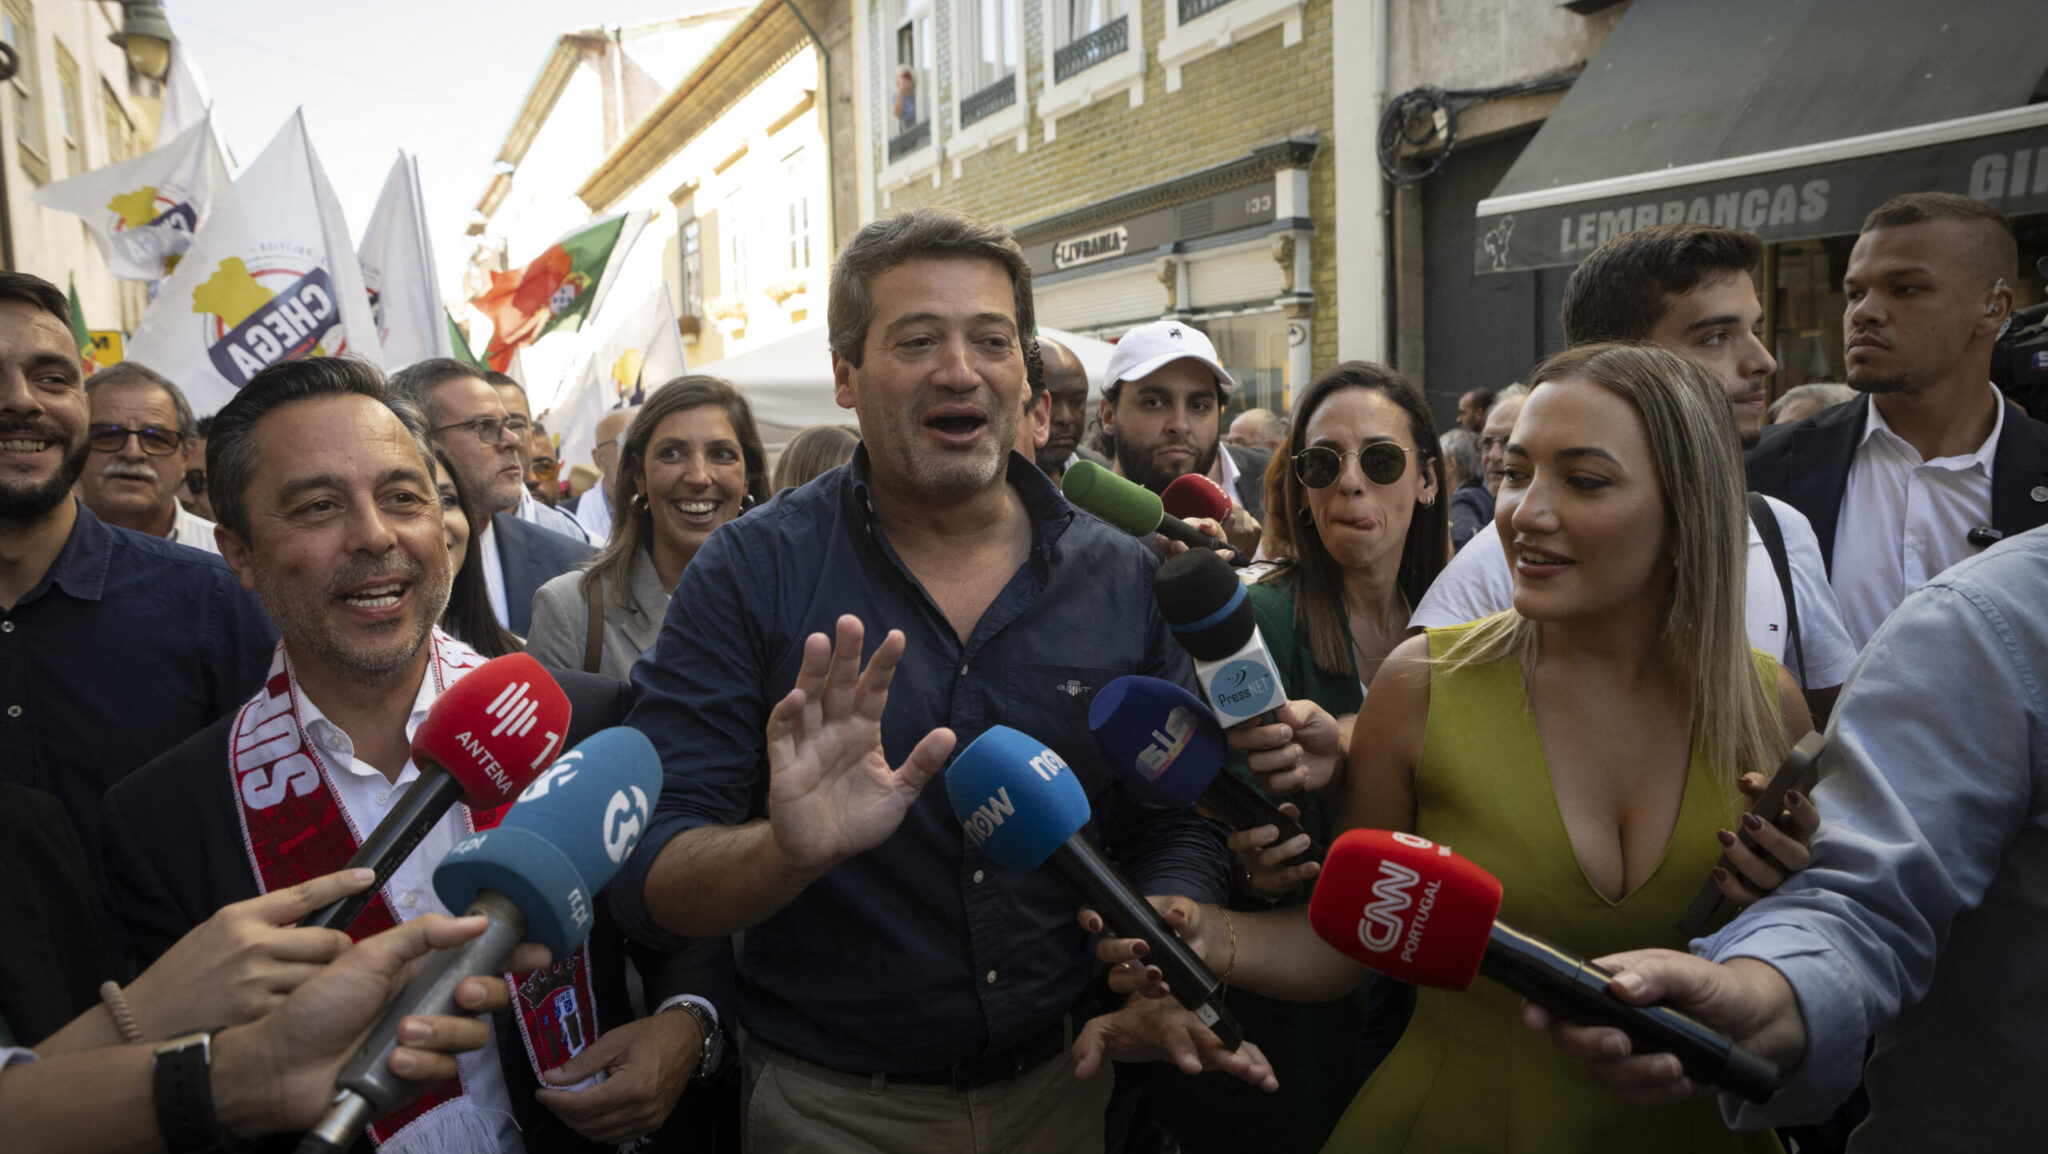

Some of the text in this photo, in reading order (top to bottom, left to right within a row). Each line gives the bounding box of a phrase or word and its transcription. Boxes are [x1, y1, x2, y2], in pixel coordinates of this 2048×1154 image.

[1968, 146, 2048, 200] GI
[1061, 231, 1121, 263] LIVRARIA
[1560, 179, 1831, 252] LEMBRANÇAS
[455, 731, 560, 795] ANTENA 1
[963, 786, 1016, 846] now
[1358, 859, 1421, 953] CNN
[1401, 880, 1442, 963] PORTUGAL
